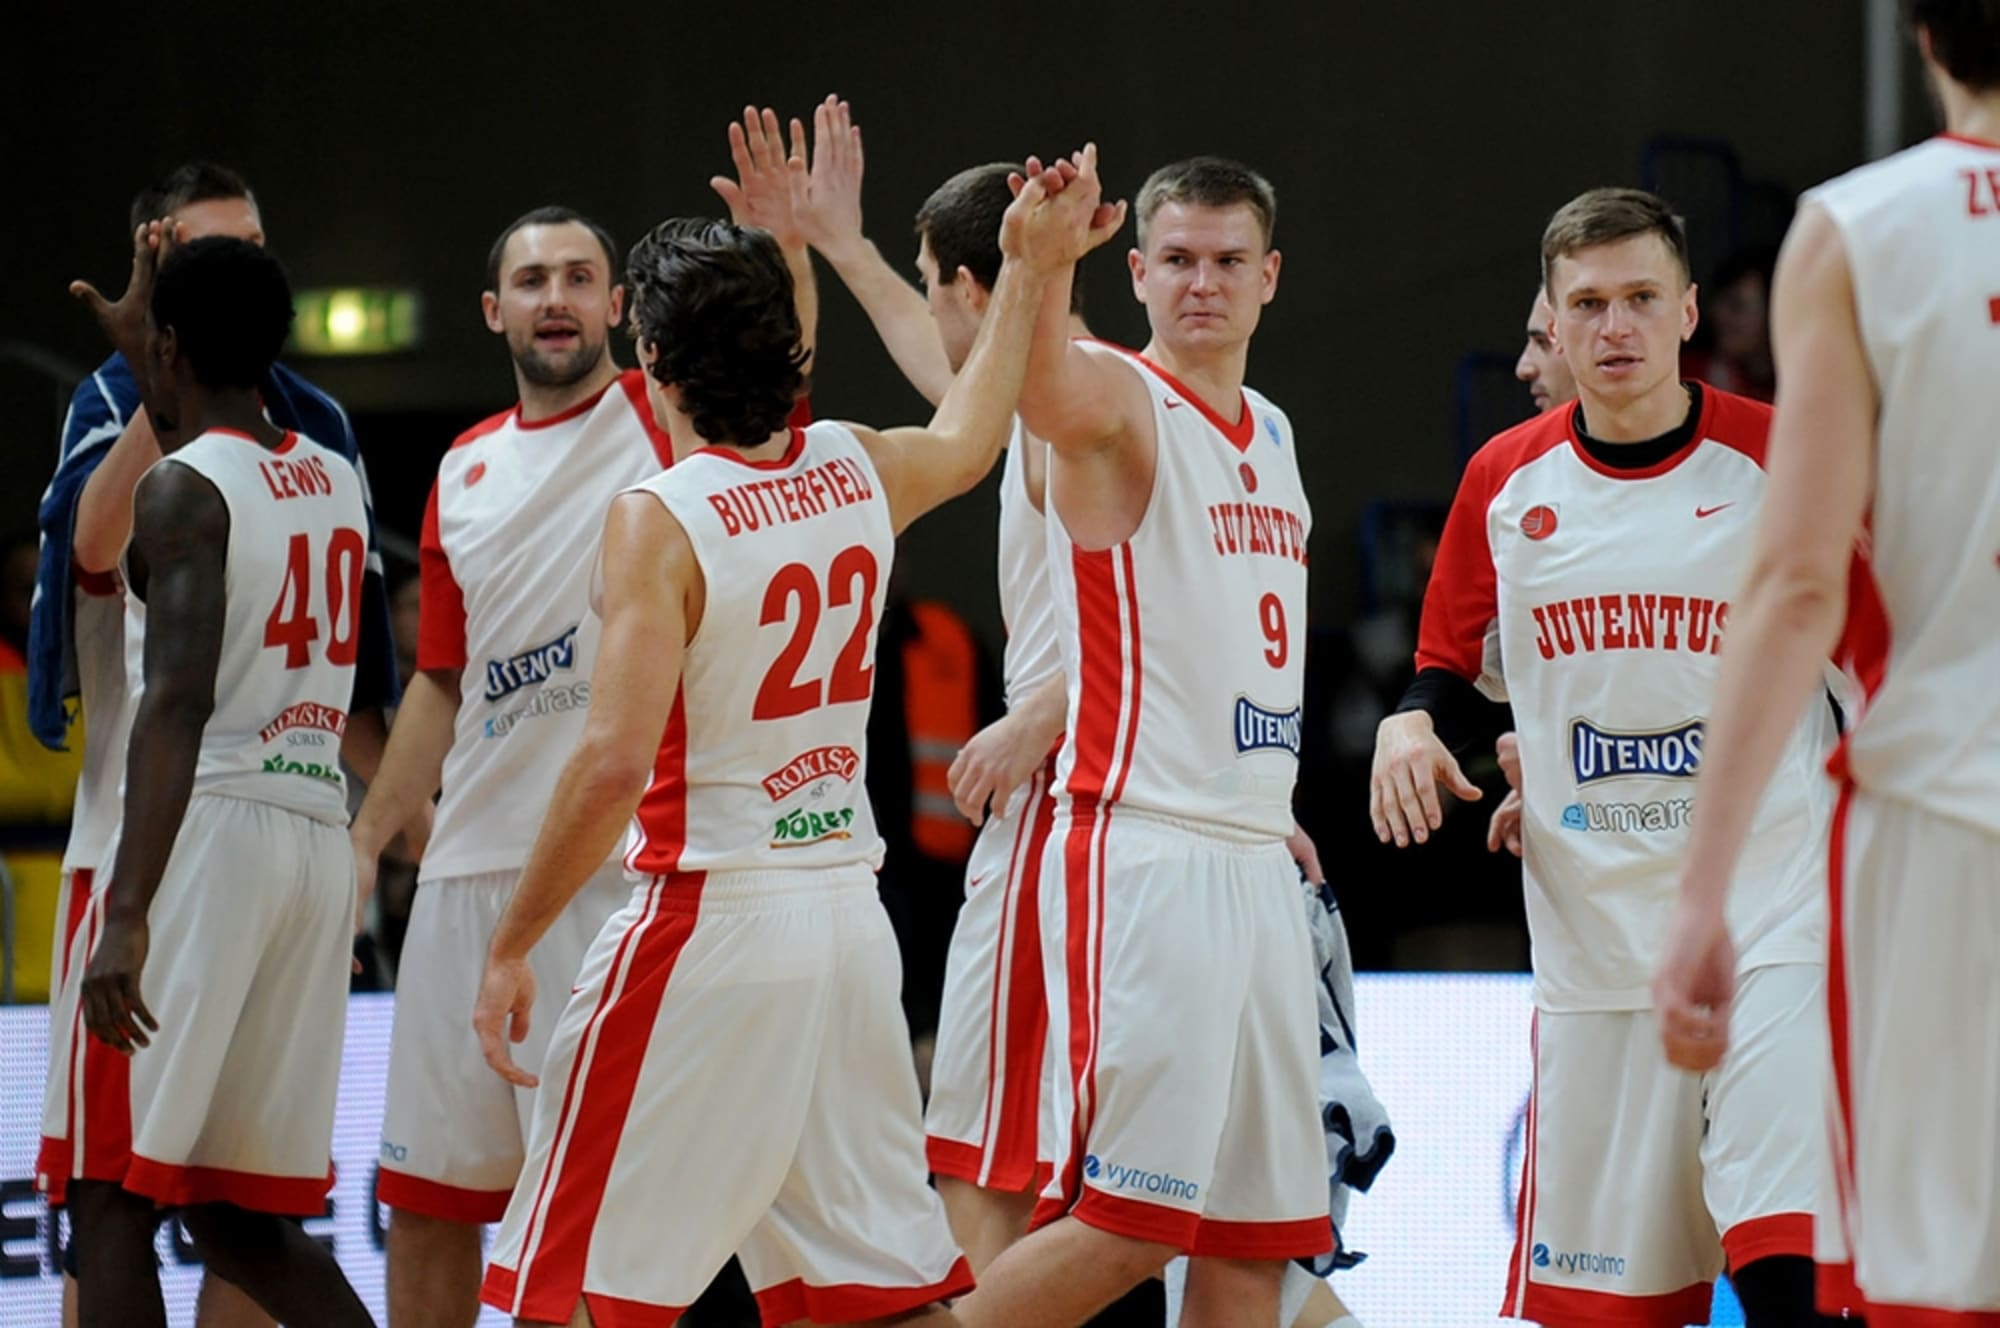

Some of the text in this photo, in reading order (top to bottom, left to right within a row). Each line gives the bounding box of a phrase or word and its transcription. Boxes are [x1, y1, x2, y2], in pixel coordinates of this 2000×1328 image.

[259, 455, 332, 500] LEWIS
[264, 527, 364, 669] 40
[752, 545, 878, 721] 22
[1259, 592, 1288, 670] 9
